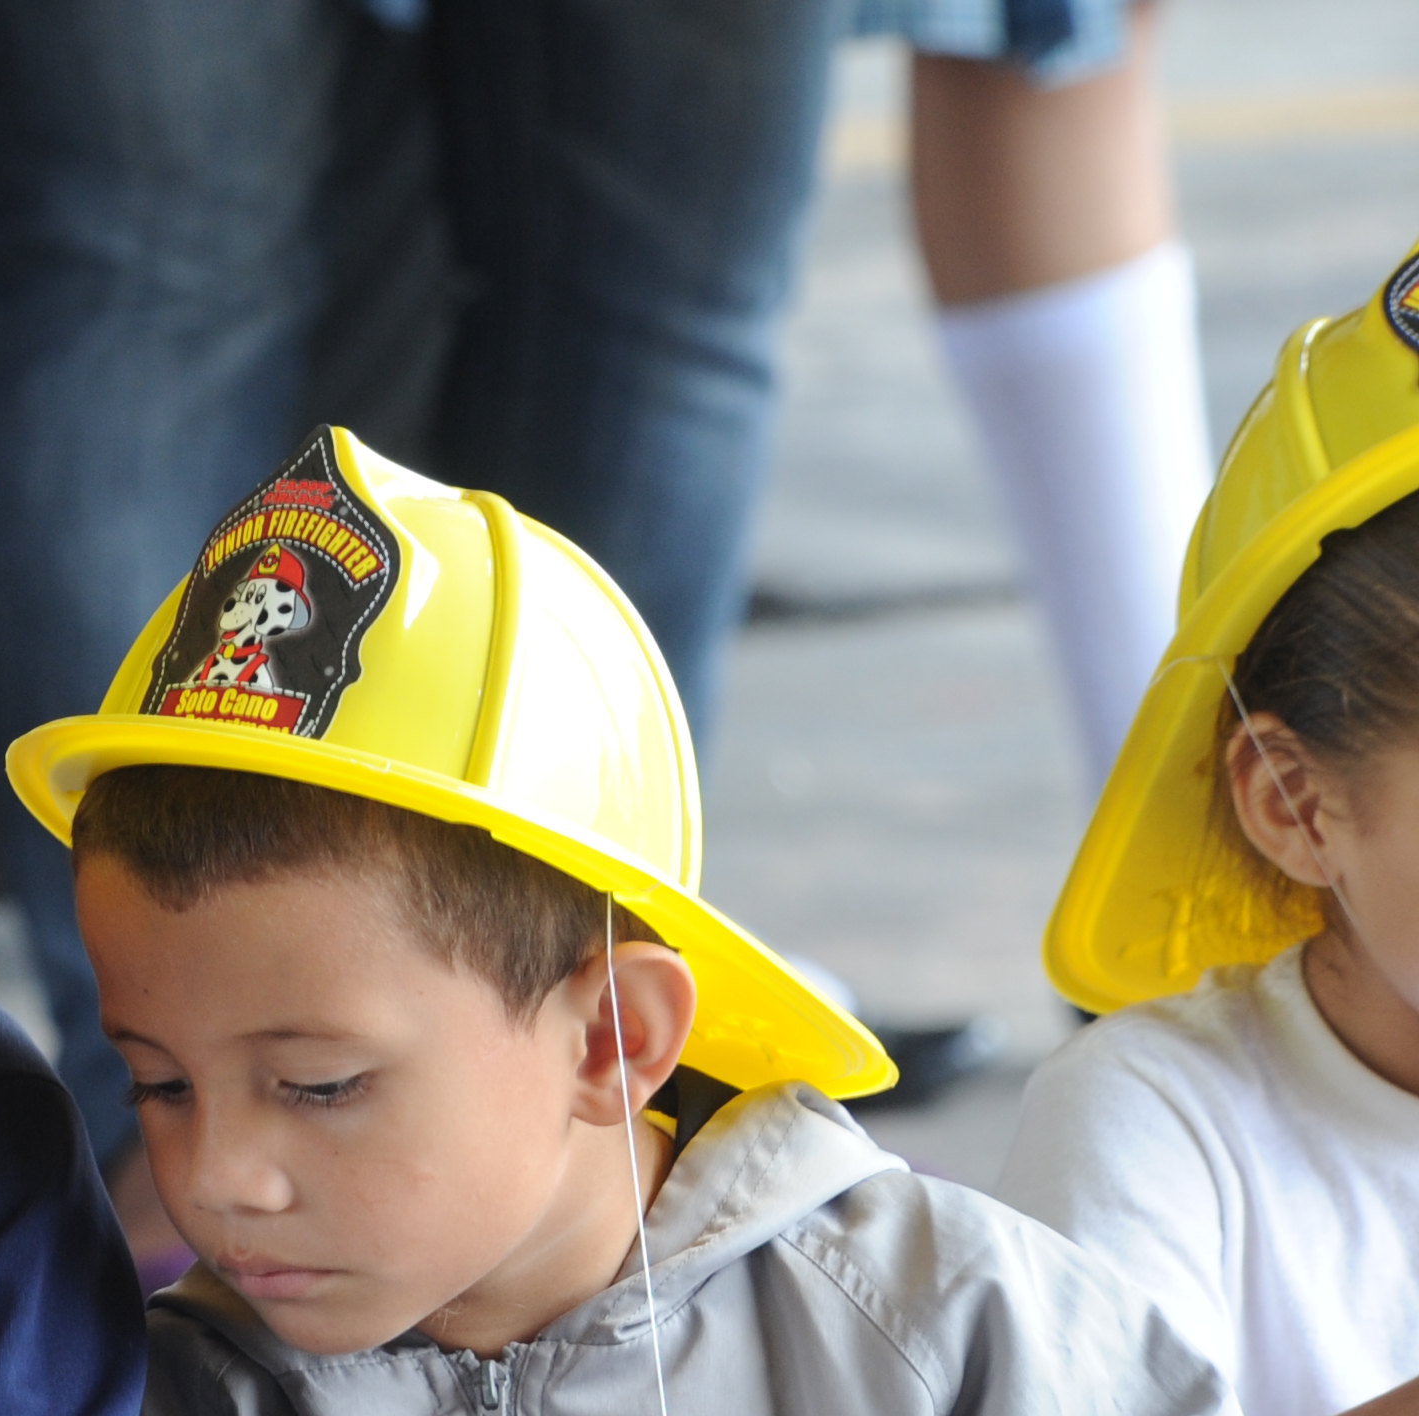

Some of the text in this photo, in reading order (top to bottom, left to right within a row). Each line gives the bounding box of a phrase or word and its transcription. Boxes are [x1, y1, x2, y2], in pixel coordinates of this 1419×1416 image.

[208, 509, 379, 581] JUNIOR FIREFIGHTER
[175, 688, 279, 722] Soto Cano
